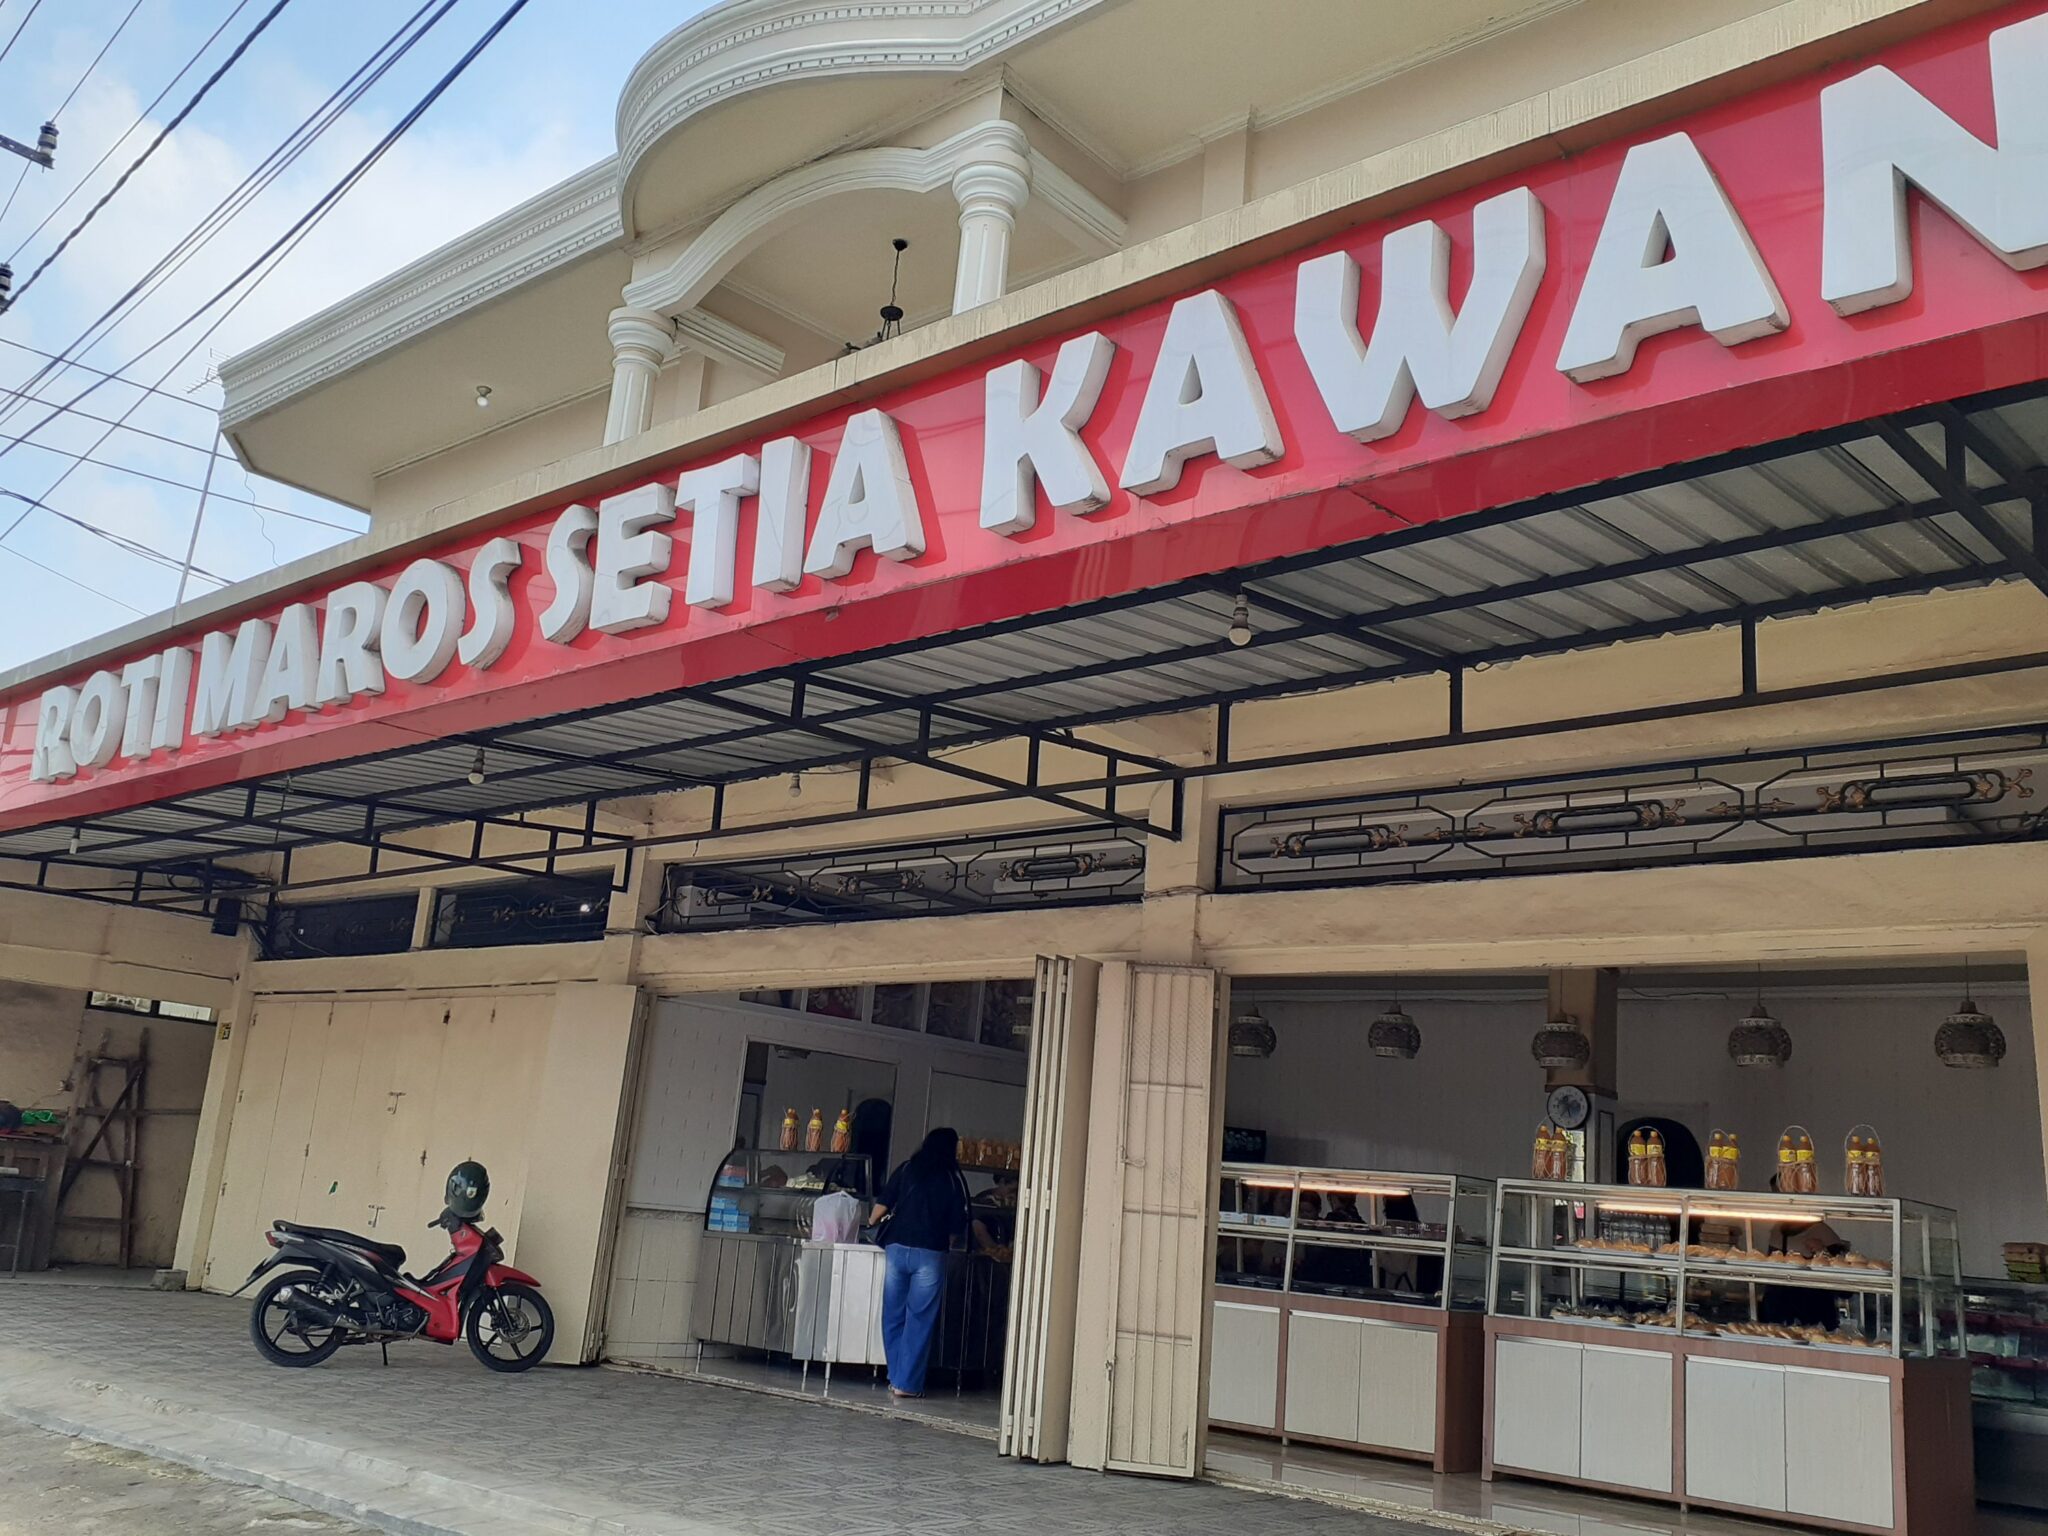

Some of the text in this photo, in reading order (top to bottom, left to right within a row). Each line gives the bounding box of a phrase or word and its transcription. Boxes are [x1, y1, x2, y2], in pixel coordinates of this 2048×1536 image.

[30, 12, 2048, 783] ROTI MAROS SETIA KAWAN
